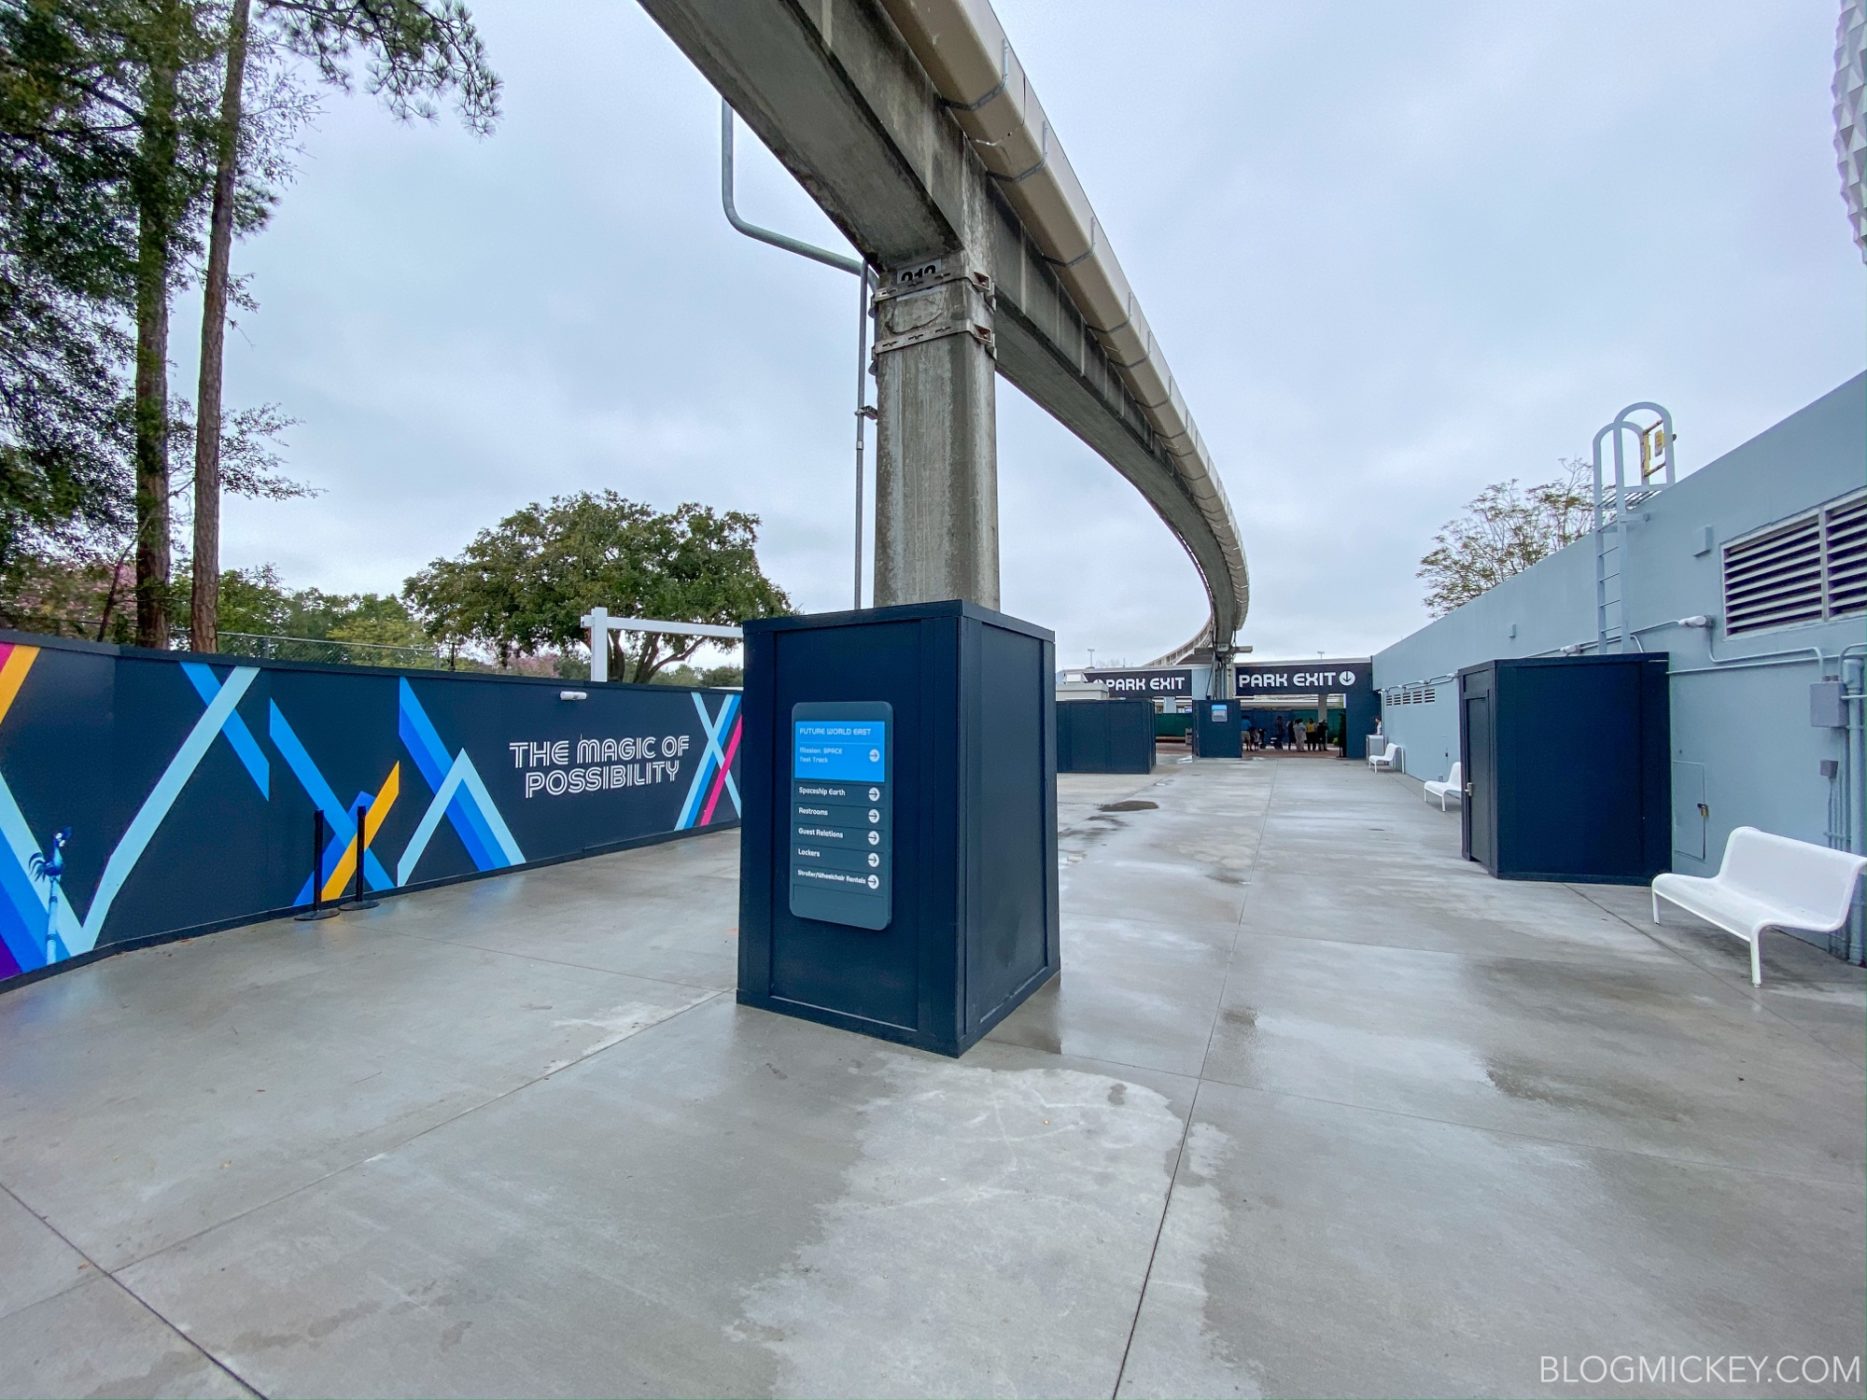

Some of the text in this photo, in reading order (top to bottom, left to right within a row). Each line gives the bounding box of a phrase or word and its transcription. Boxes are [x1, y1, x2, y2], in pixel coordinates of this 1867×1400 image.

[1106, 677, 1185, 691] PARK EXIT
[1238, 672, 1337, 688] PARK EXIT
[799, 727, 872, 736] FUTURE WORLD EAST
[509, 735, 690, 768] THE MAGIC OF
[525, 760, 680, 798] POSSIBILITY
[798, 787, 846, 796] Spaceship Earth
[798, 807, 828, 816] Restrooms
[798, 828, 844, 839] Guest Relations
[797, 848, 820, 857] Lockers
